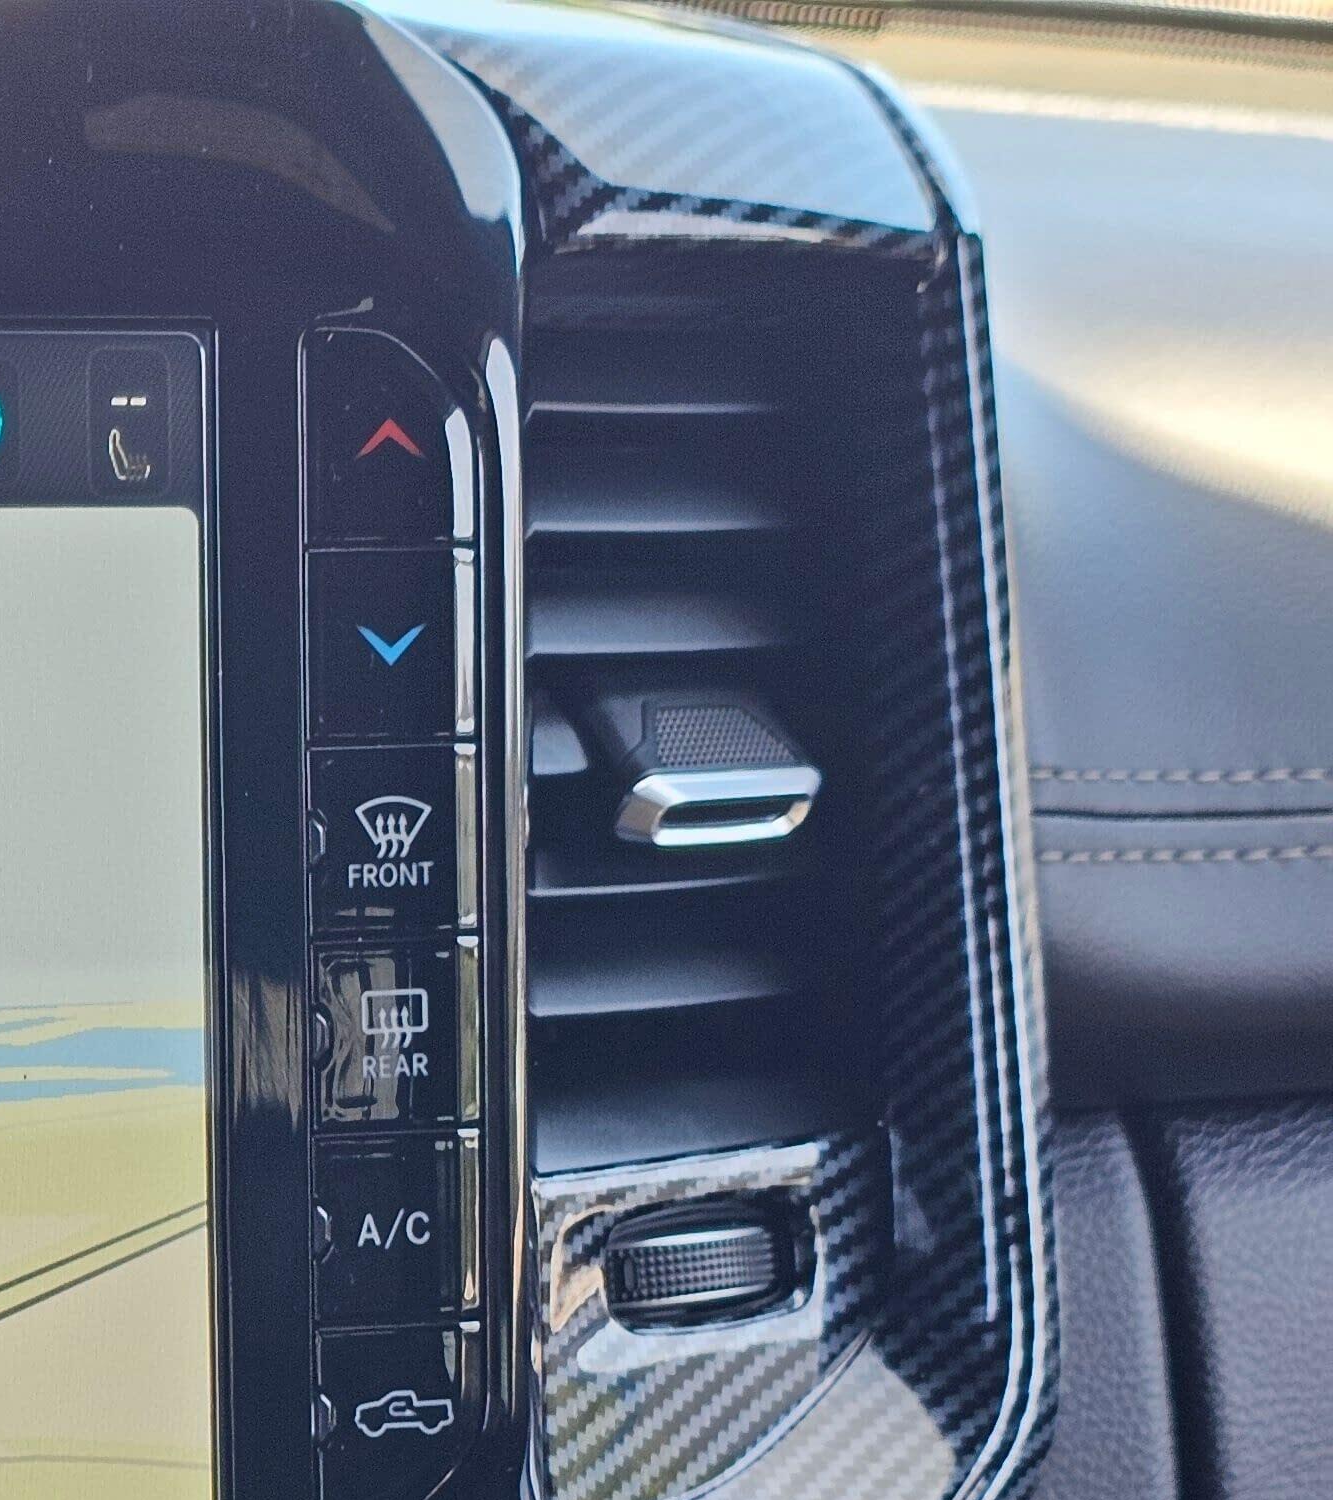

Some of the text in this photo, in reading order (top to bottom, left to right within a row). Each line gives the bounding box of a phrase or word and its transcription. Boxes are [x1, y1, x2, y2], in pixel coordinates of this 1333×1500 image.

[347, 861, 434, 889] FRONT
[361, 1054, 429, 1080] REAR
[357, 1208, 431, 1248] A/C
